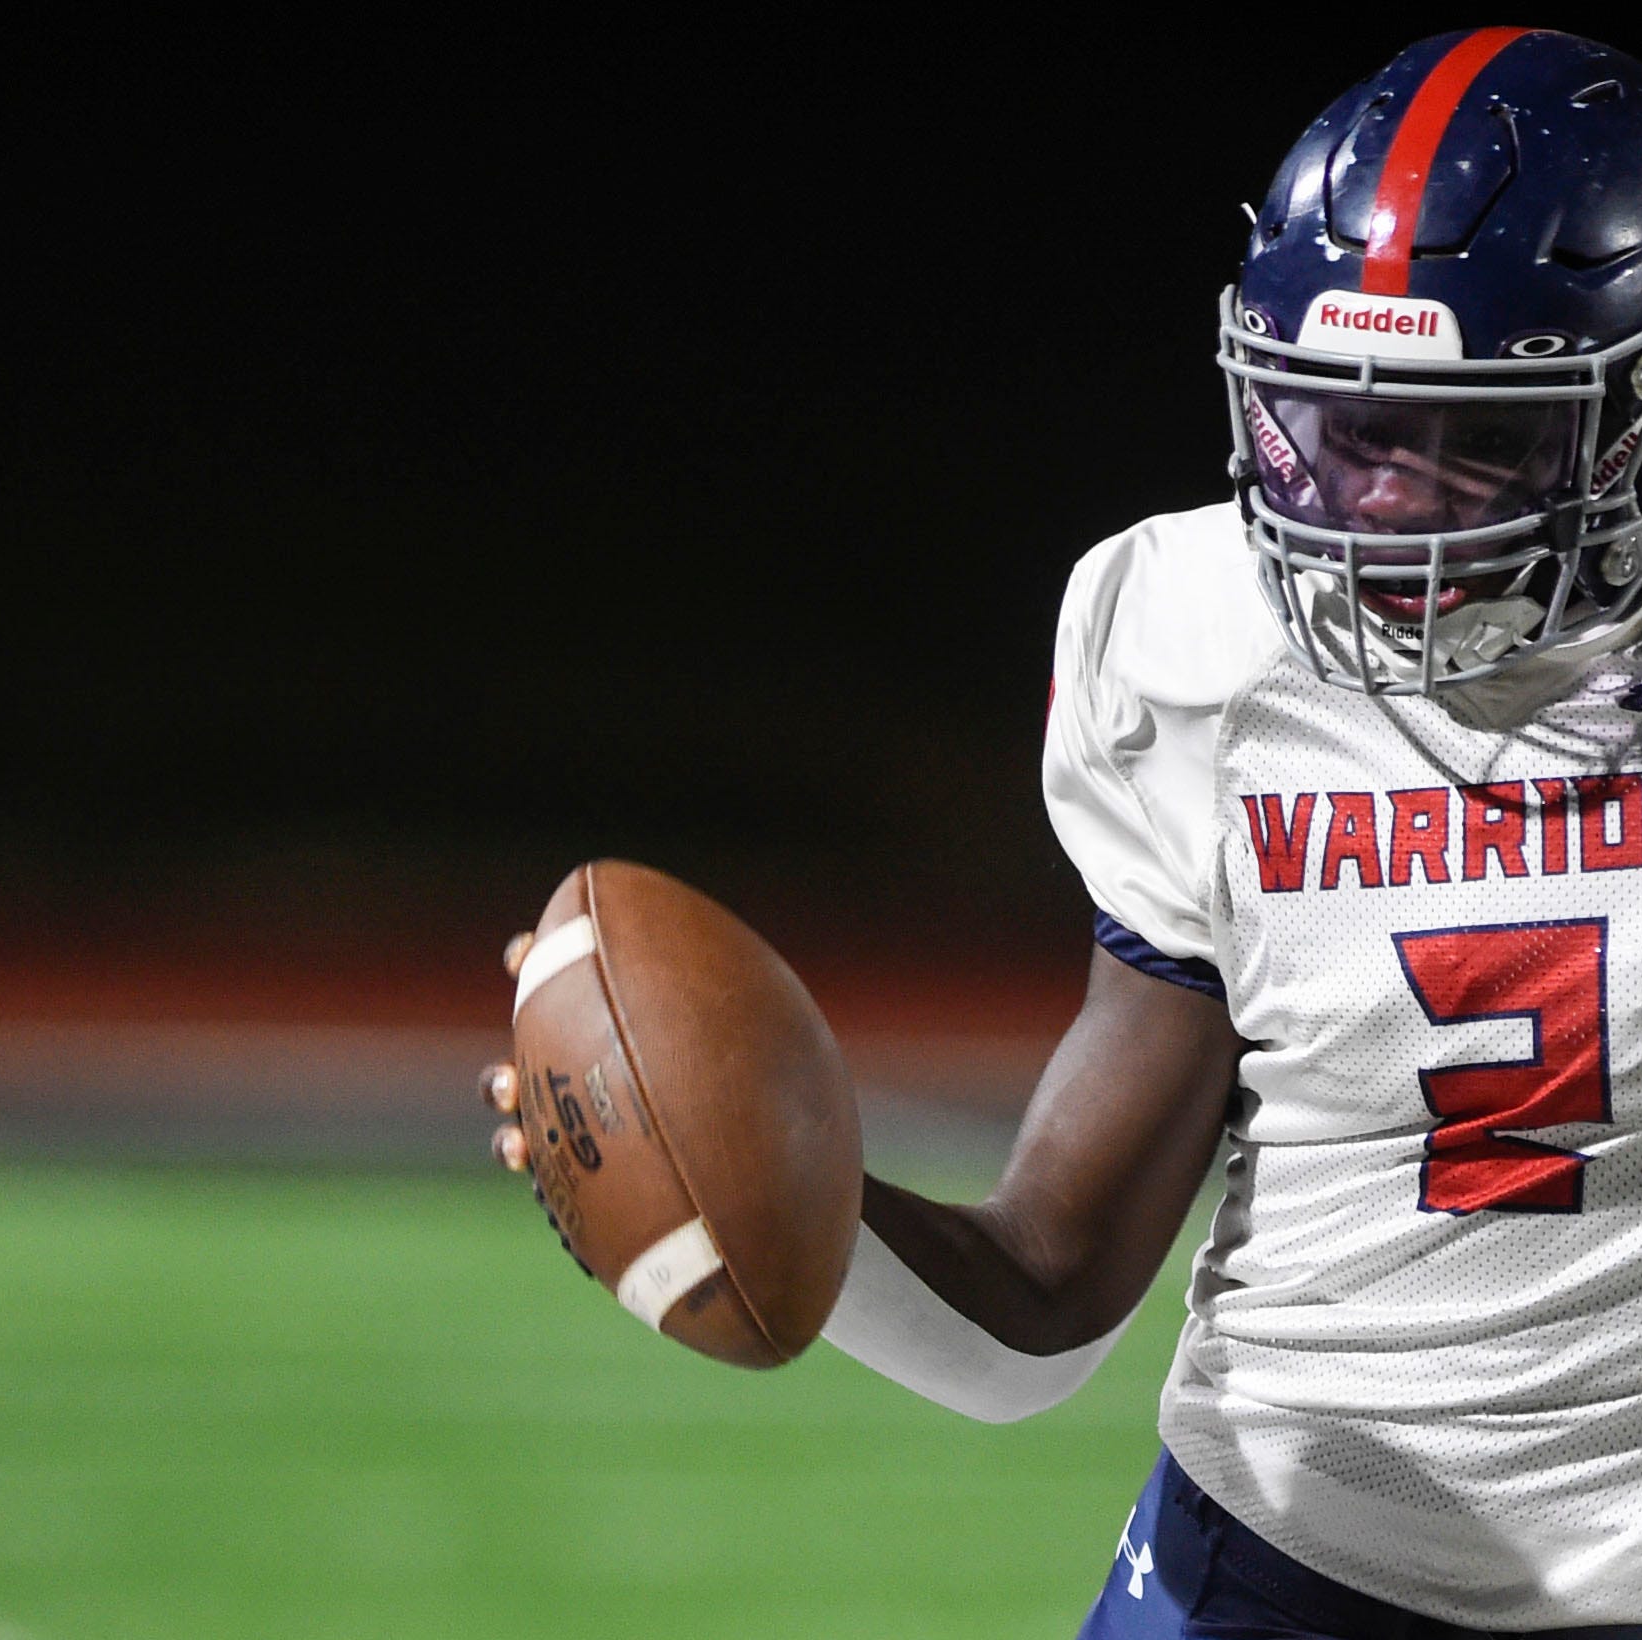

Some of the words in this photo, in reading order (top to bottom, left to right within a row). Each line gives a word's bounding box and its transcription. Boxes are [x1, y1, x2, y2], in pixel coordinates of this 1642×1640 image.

[1320, 303, 1439, 337] Riddell
[1590, 431, 1638, 495] ddell
[1381, 623, 1425, 640] Ridde
[1391, 915, 1612, 1215] 2
